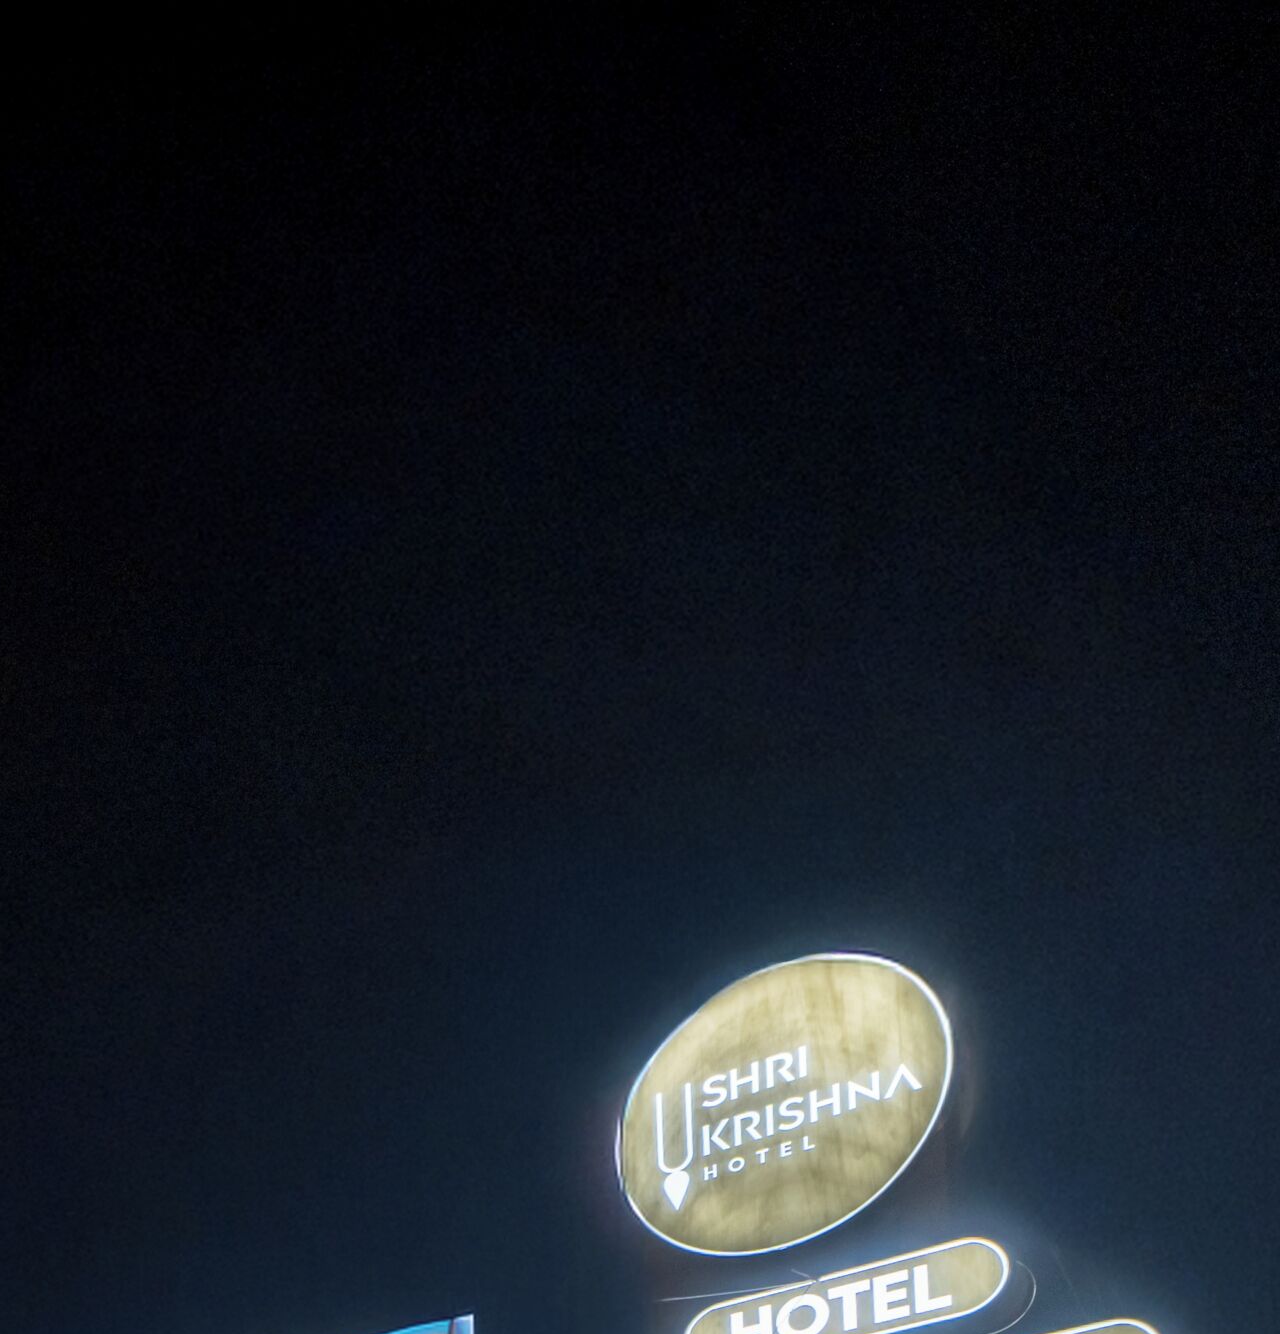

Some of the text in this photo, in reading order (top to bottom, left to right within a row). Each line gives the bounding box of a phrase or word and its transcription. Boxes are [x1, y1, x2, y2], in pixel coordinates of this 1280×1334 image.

[701, 1045, 807, 1107] SHRI
[702, 1063, 922, 1156] KRISHNA
[703, 1135, 815, 1181] HOTEL
